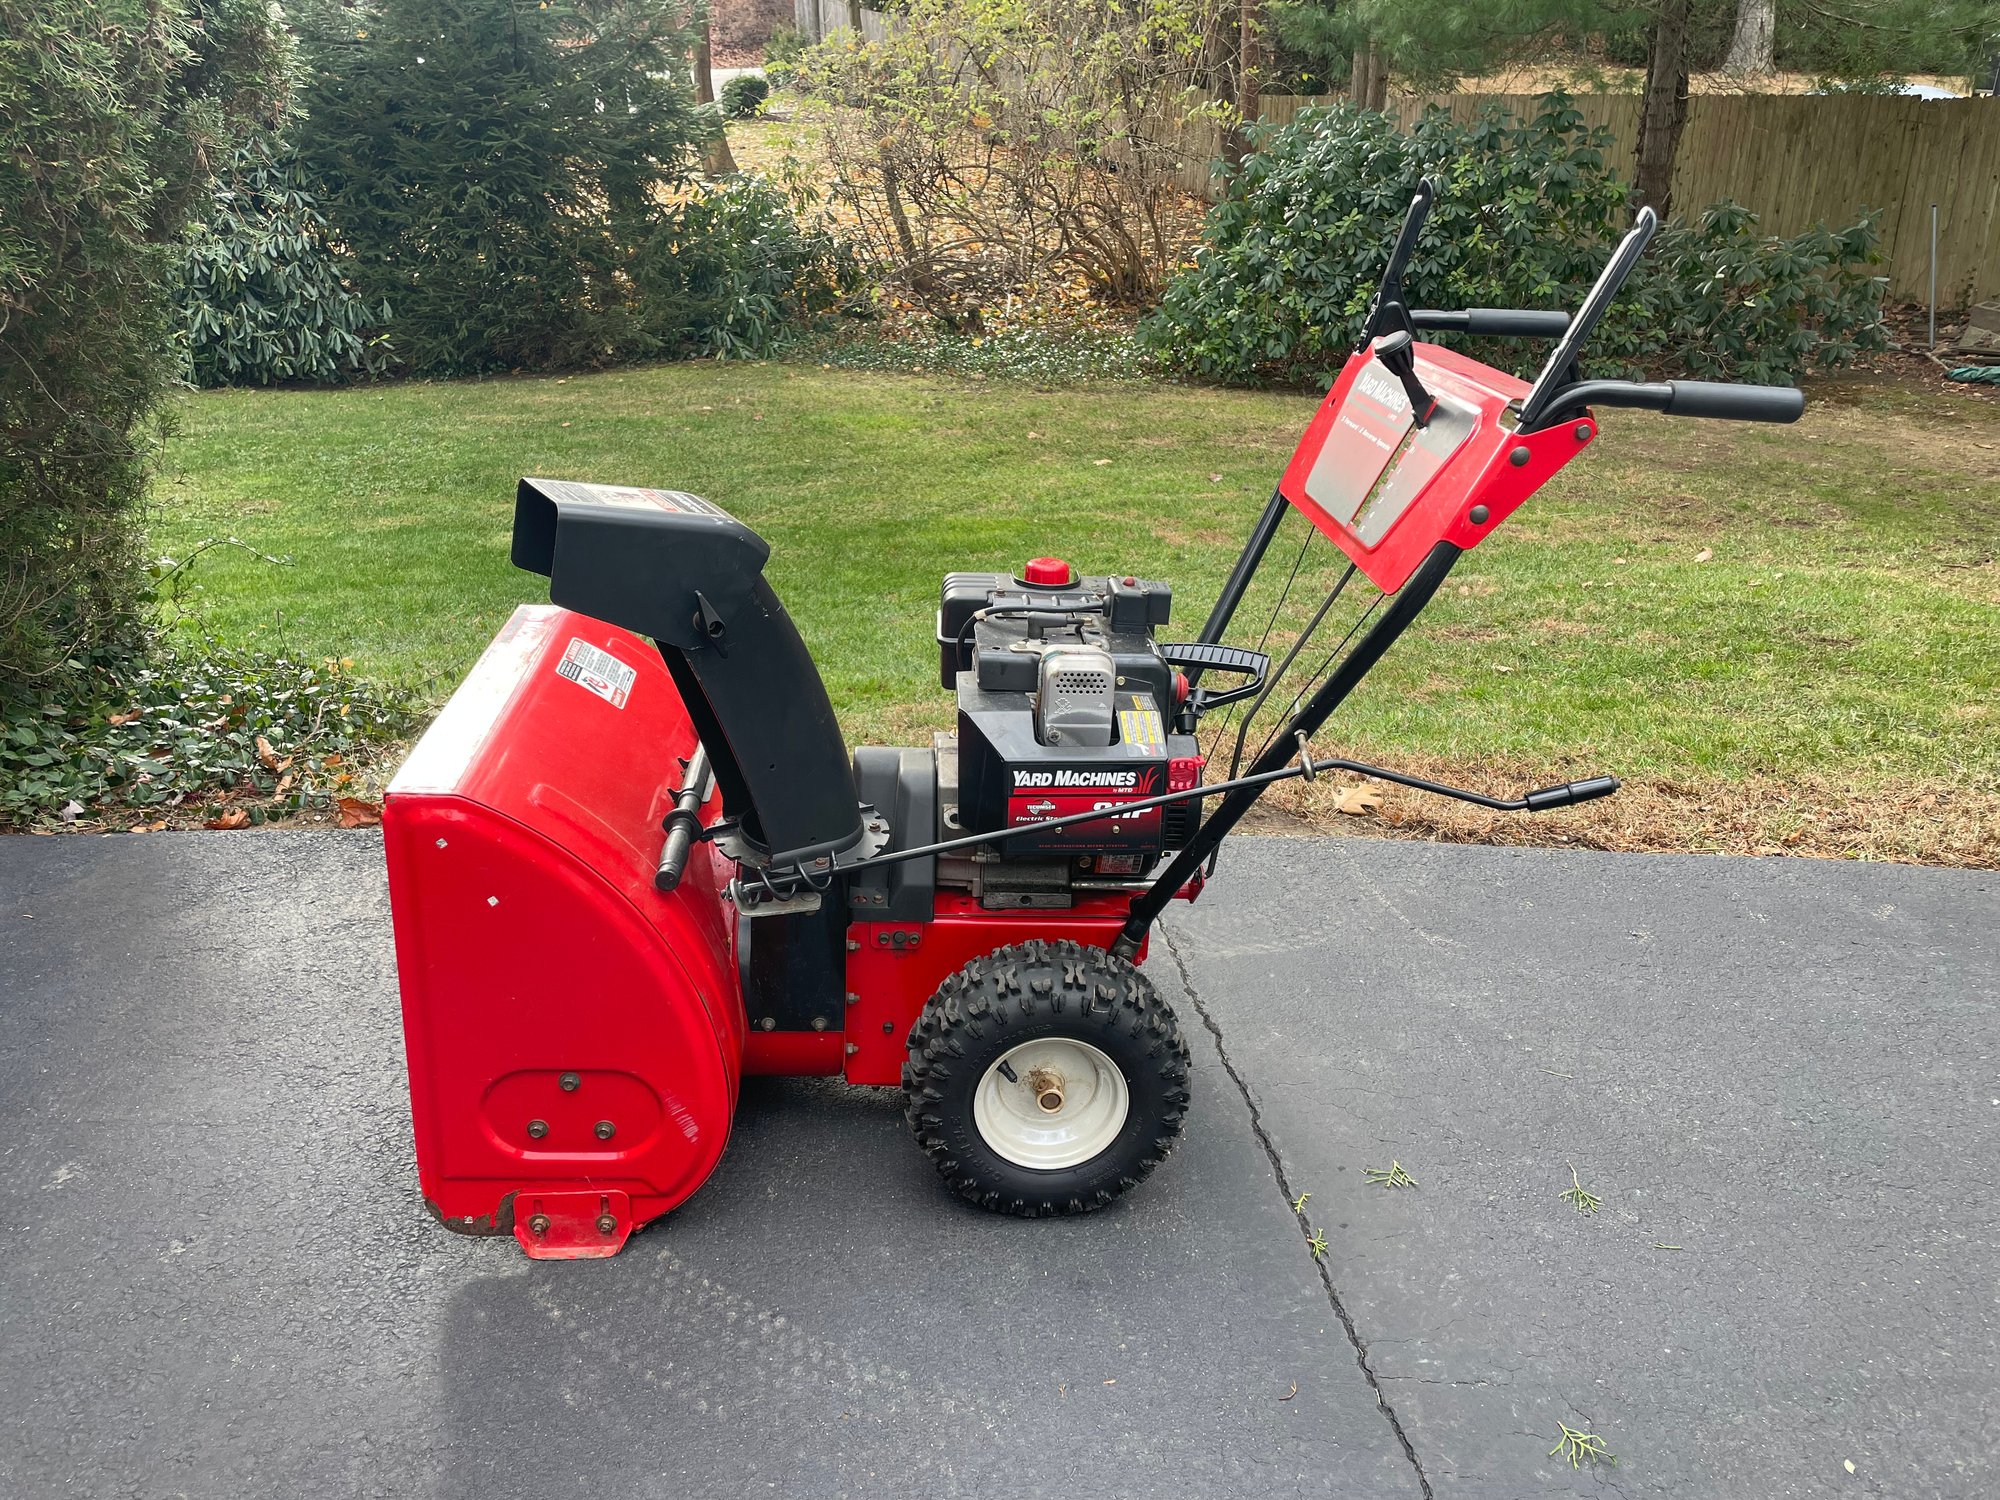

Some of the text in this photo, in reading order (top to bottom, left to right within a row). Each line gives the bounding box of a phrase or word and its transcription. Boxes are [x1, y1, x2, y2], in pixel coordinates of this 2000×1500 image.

[1386, 482, 1394, 490] 2
[1013, 770, 1136, 787] YARD MACHINES
